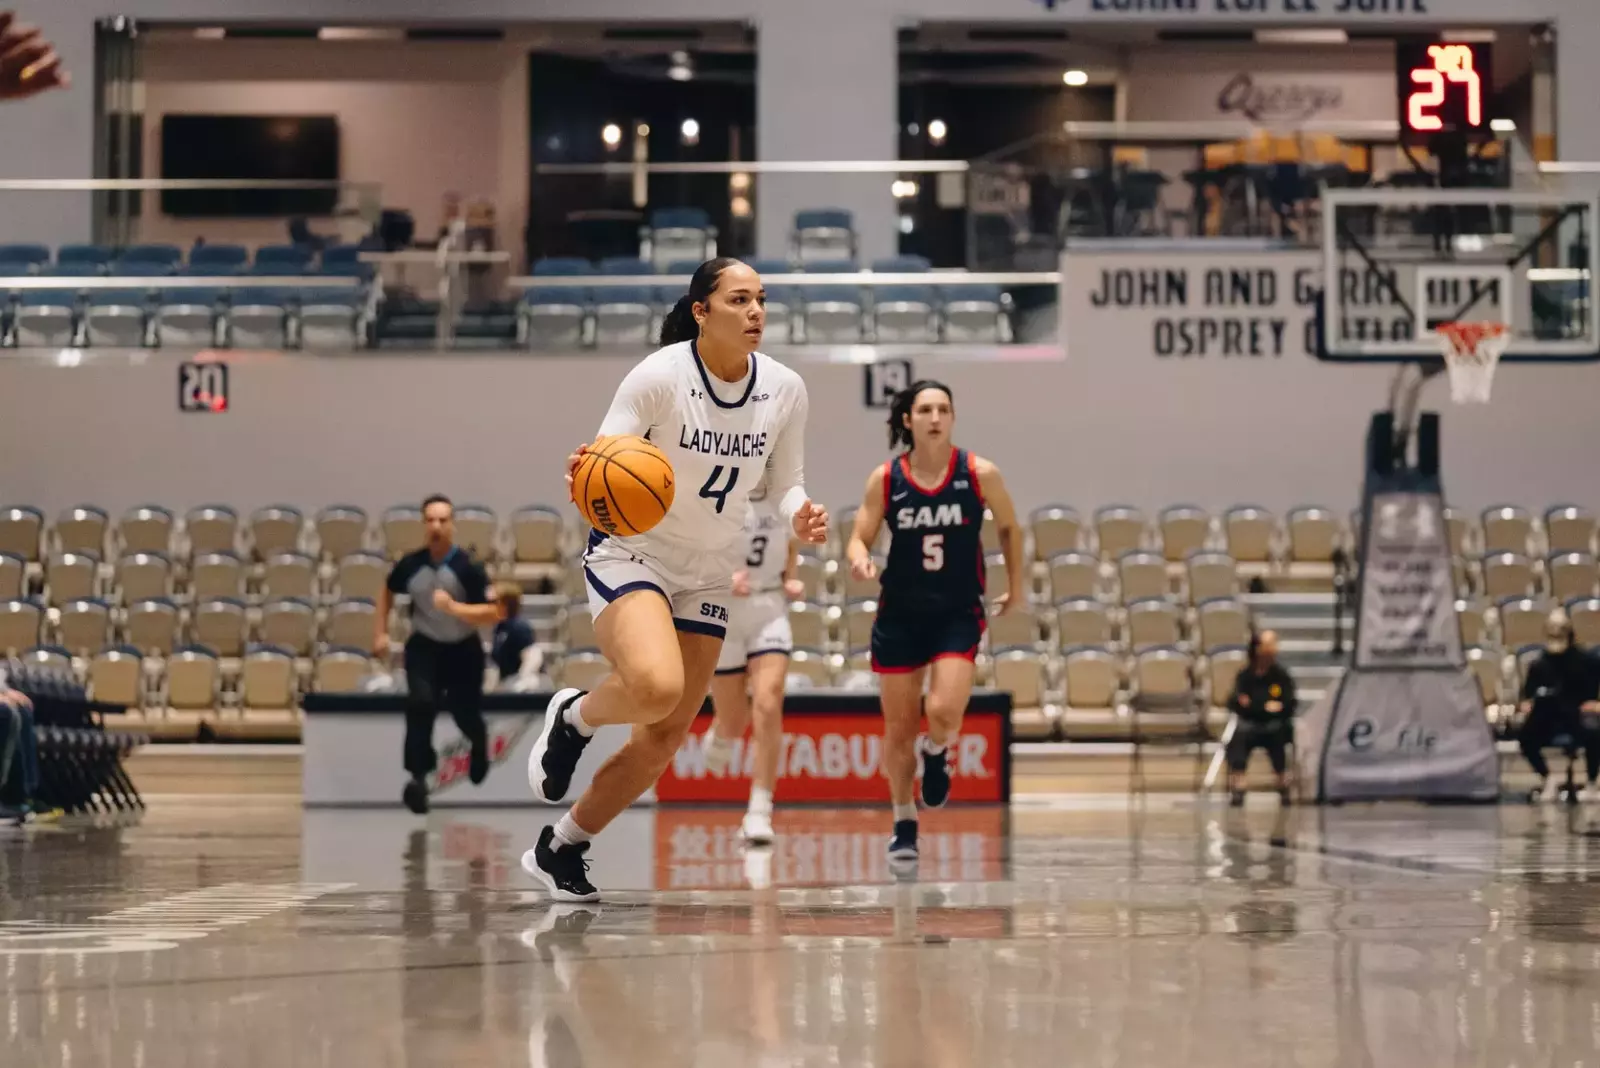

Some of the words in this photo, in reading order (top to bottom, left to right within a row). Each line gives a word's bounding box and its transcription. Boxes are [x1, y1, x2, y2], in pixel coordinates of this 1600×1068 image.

[1091, 268, 1188, 307] JOHN
[1205, 268, 1276, 307] AND
[1154, 317, 1287, 357] OSPREY
[183, 365, 224, 410] 20
[698, 465, 740, 514] 4
[746, 536, 769, 567] 3
[922, 534, 944, 572] 5
